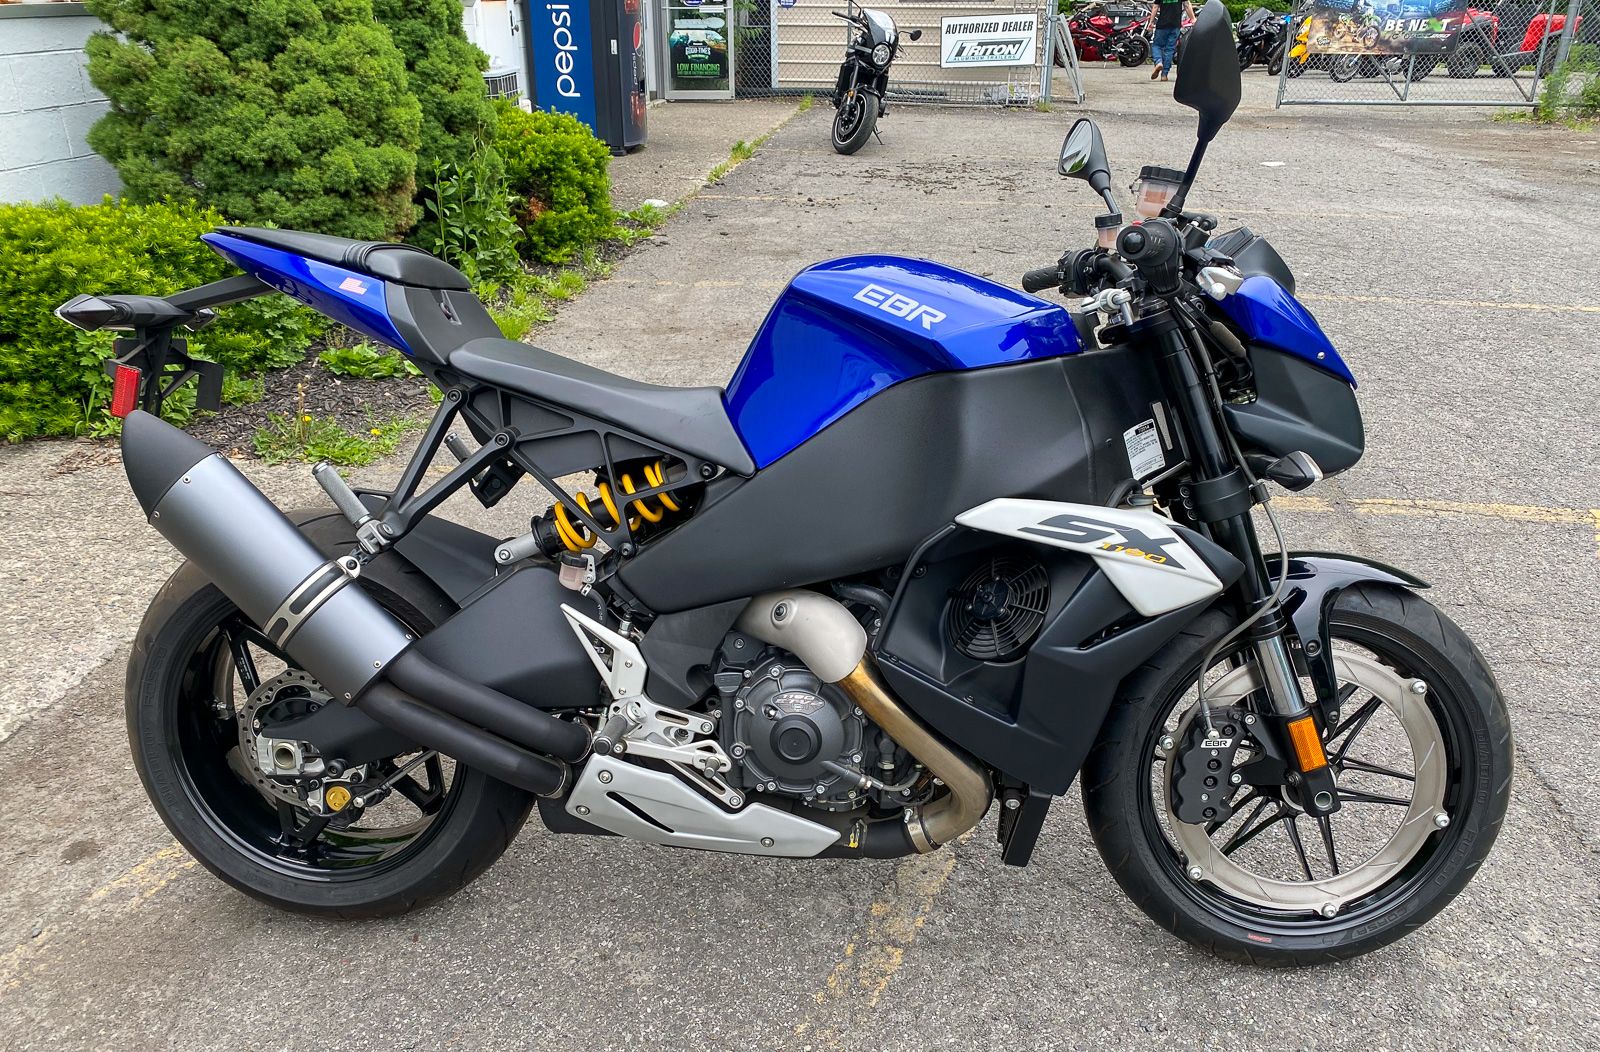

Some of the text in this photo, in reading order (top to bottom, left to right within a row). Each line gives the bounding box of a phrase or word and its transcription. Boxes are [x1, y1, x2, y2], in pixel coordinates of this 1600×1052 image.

[945, 21, 1034, 34] AUTHORIZED DEALER
[1384, 19, 1405, 31] BE
[547, 4, 580, 97] pepsi
[961, 42, 1020, 56] TRITON
[676, 63, 720, 71] LOW FINANCING
[852, 283, 947, 331] EBR
[1017, 513, 1187, 570] SX
